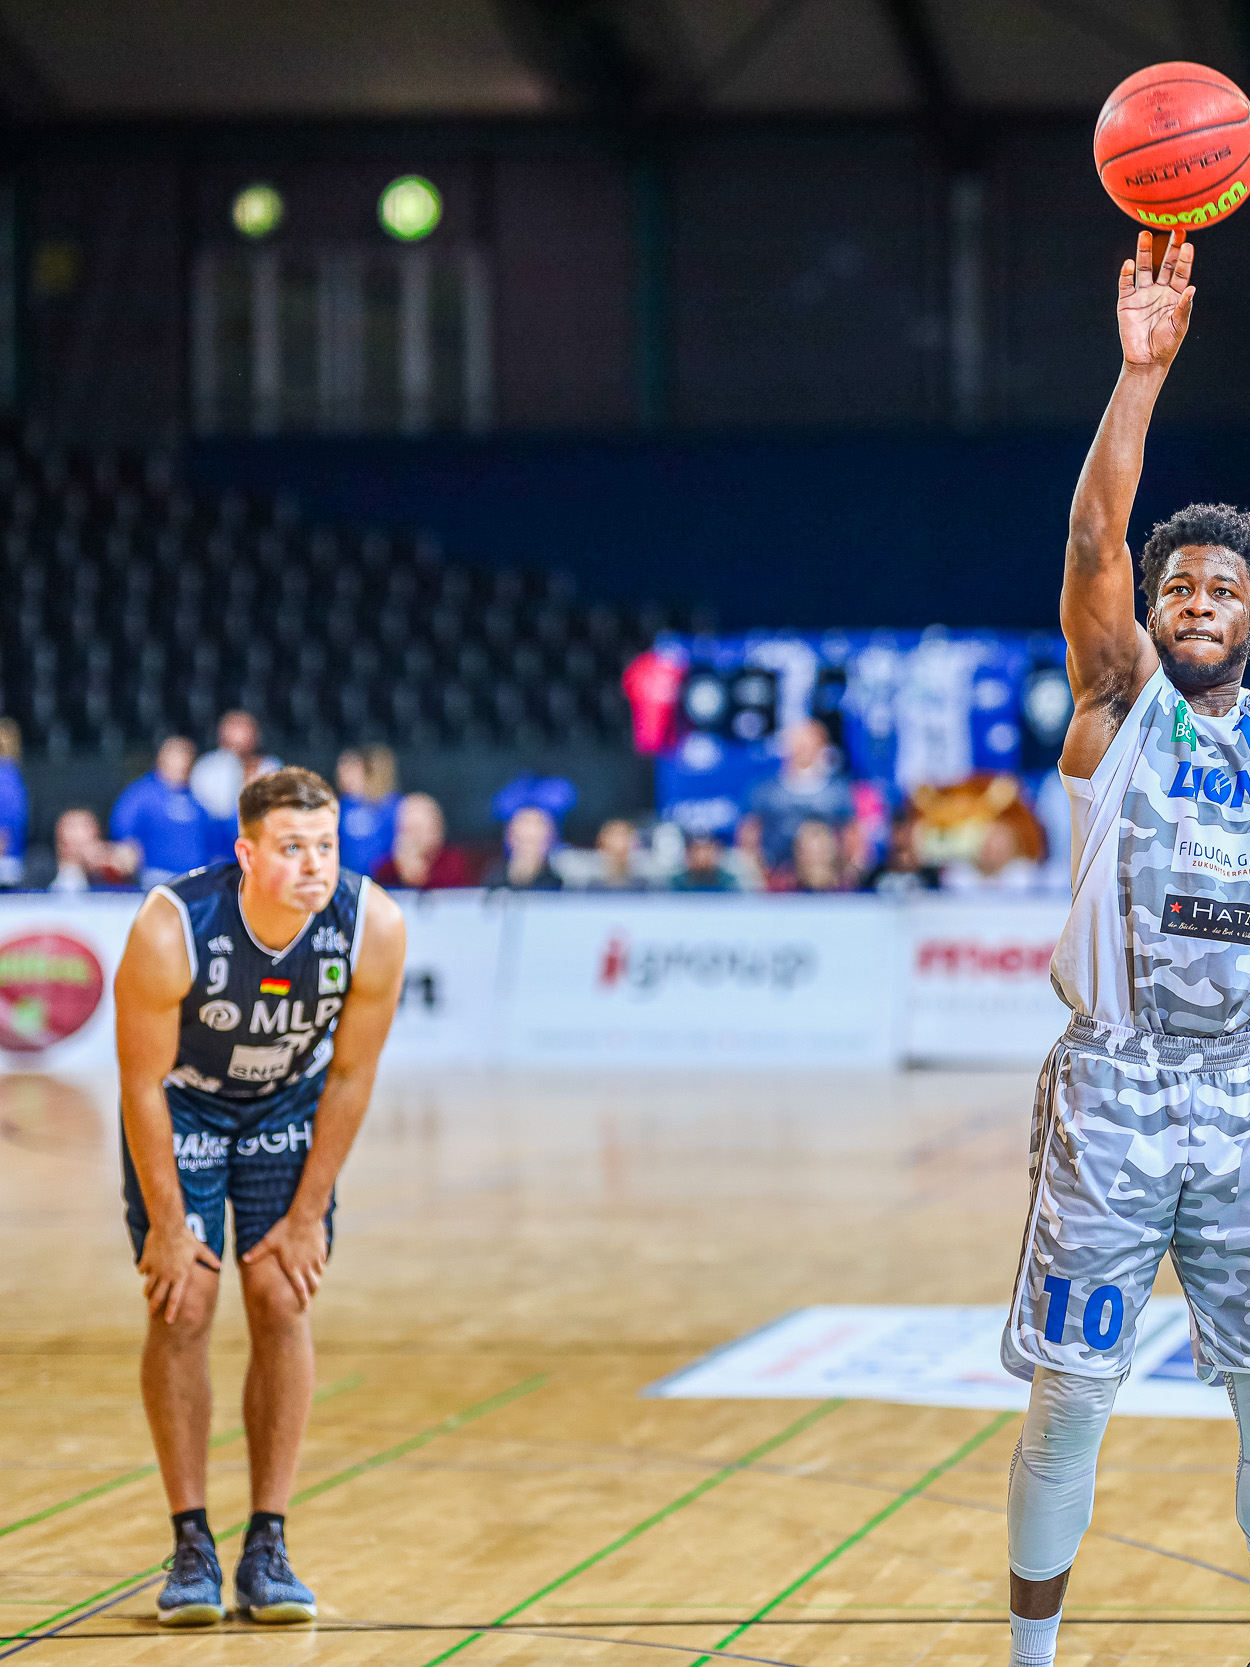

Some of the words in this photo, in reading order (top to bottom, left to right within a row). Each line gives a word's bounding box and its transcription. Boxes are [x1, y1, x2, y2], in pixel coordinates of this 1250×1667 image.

[1124, 145, 1232, 188] SOLUTION
[1136, 180, 1248, 225] Wilson
[1179, 841, 1233, 868] FIDUCIA
[206, 956, 229, 996] 9
[249, 996, 343, 1034] MLP
[1044, 1274, 1124, 1350] 10
